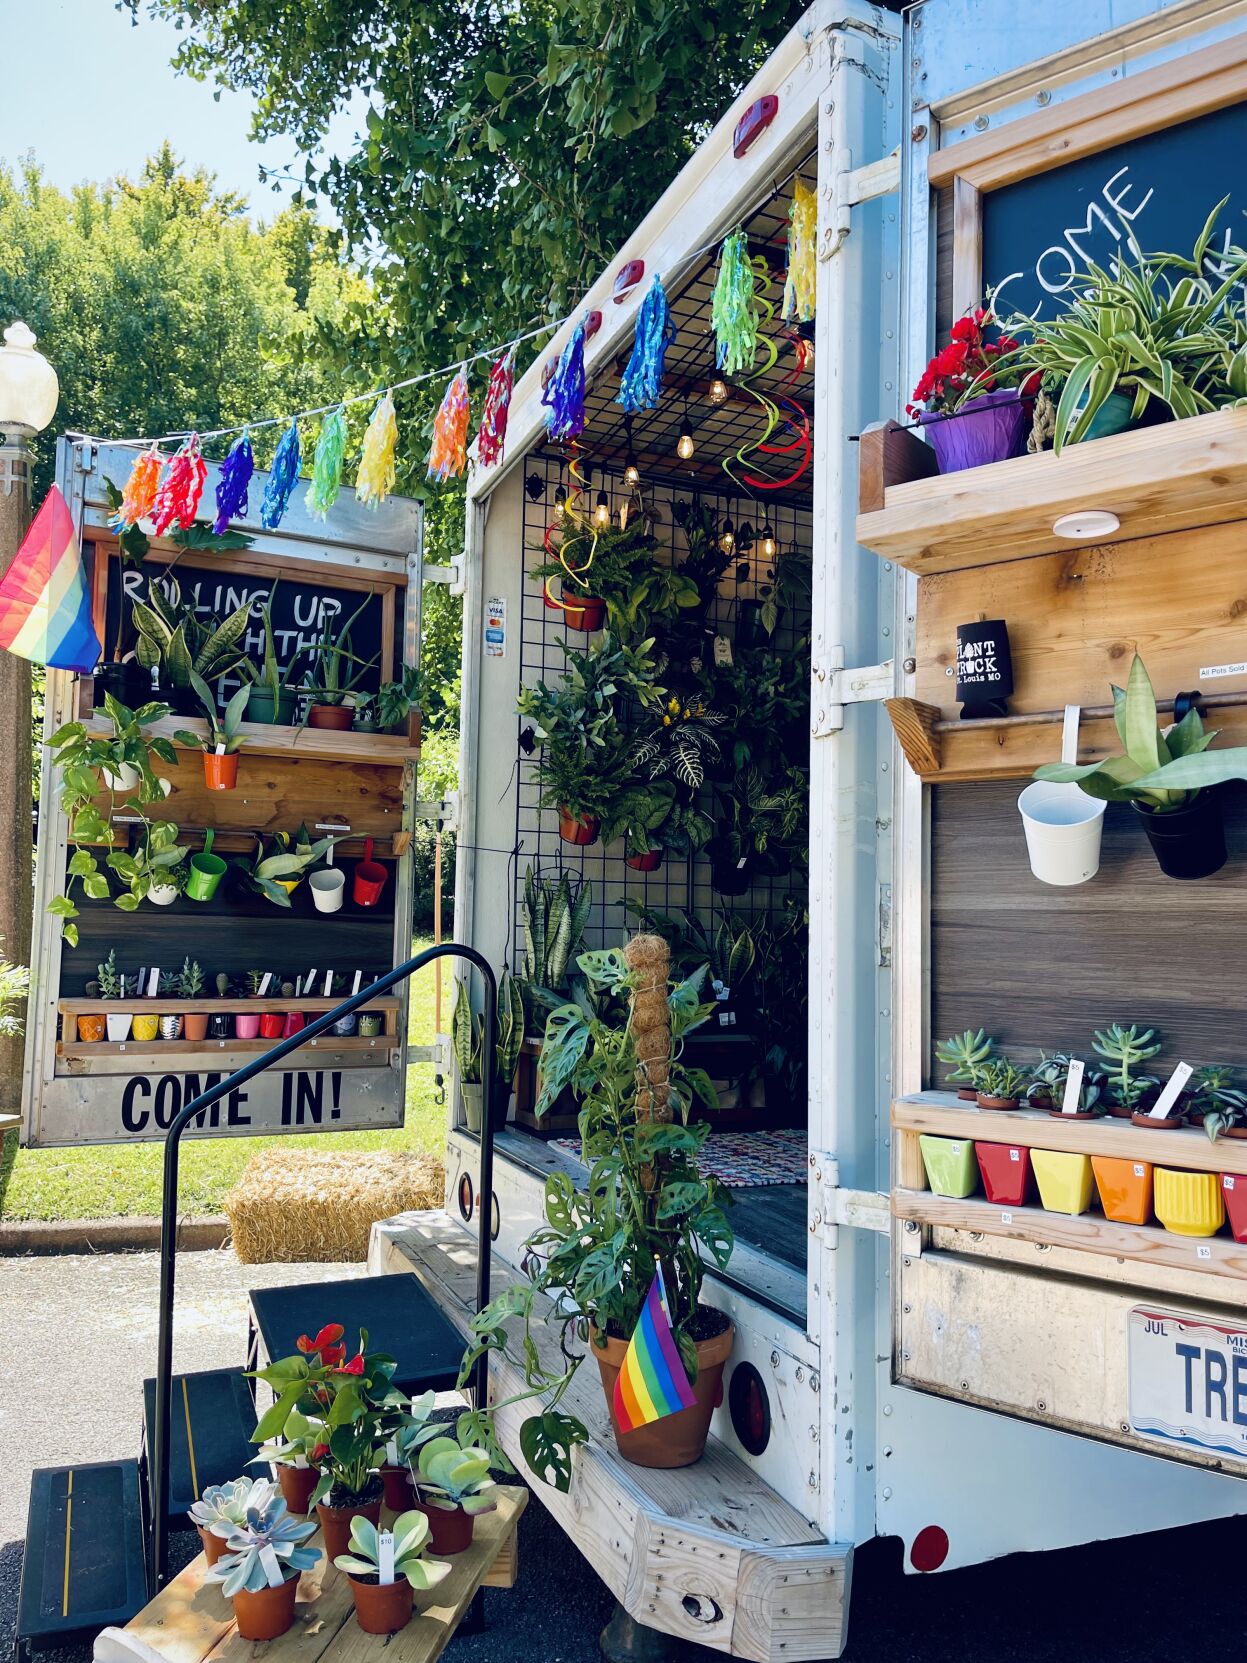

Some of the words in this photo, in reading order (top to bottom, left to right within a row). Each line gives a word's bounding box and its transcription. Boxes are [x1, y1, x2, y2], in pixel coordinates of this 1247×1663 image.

[990, 166, 1154, 331] COME
[122, 570, 271, 619] ROLLING
[294, 595, 342, 629] UP
[963, 673, 985, 683] Louis
[987, 672, 1001, 681] MO
[121, 1073, 251, 1132] COME
[281, 1071, 342, 1126] IN!
[1144, 1320, 1168, 1336] JUL
